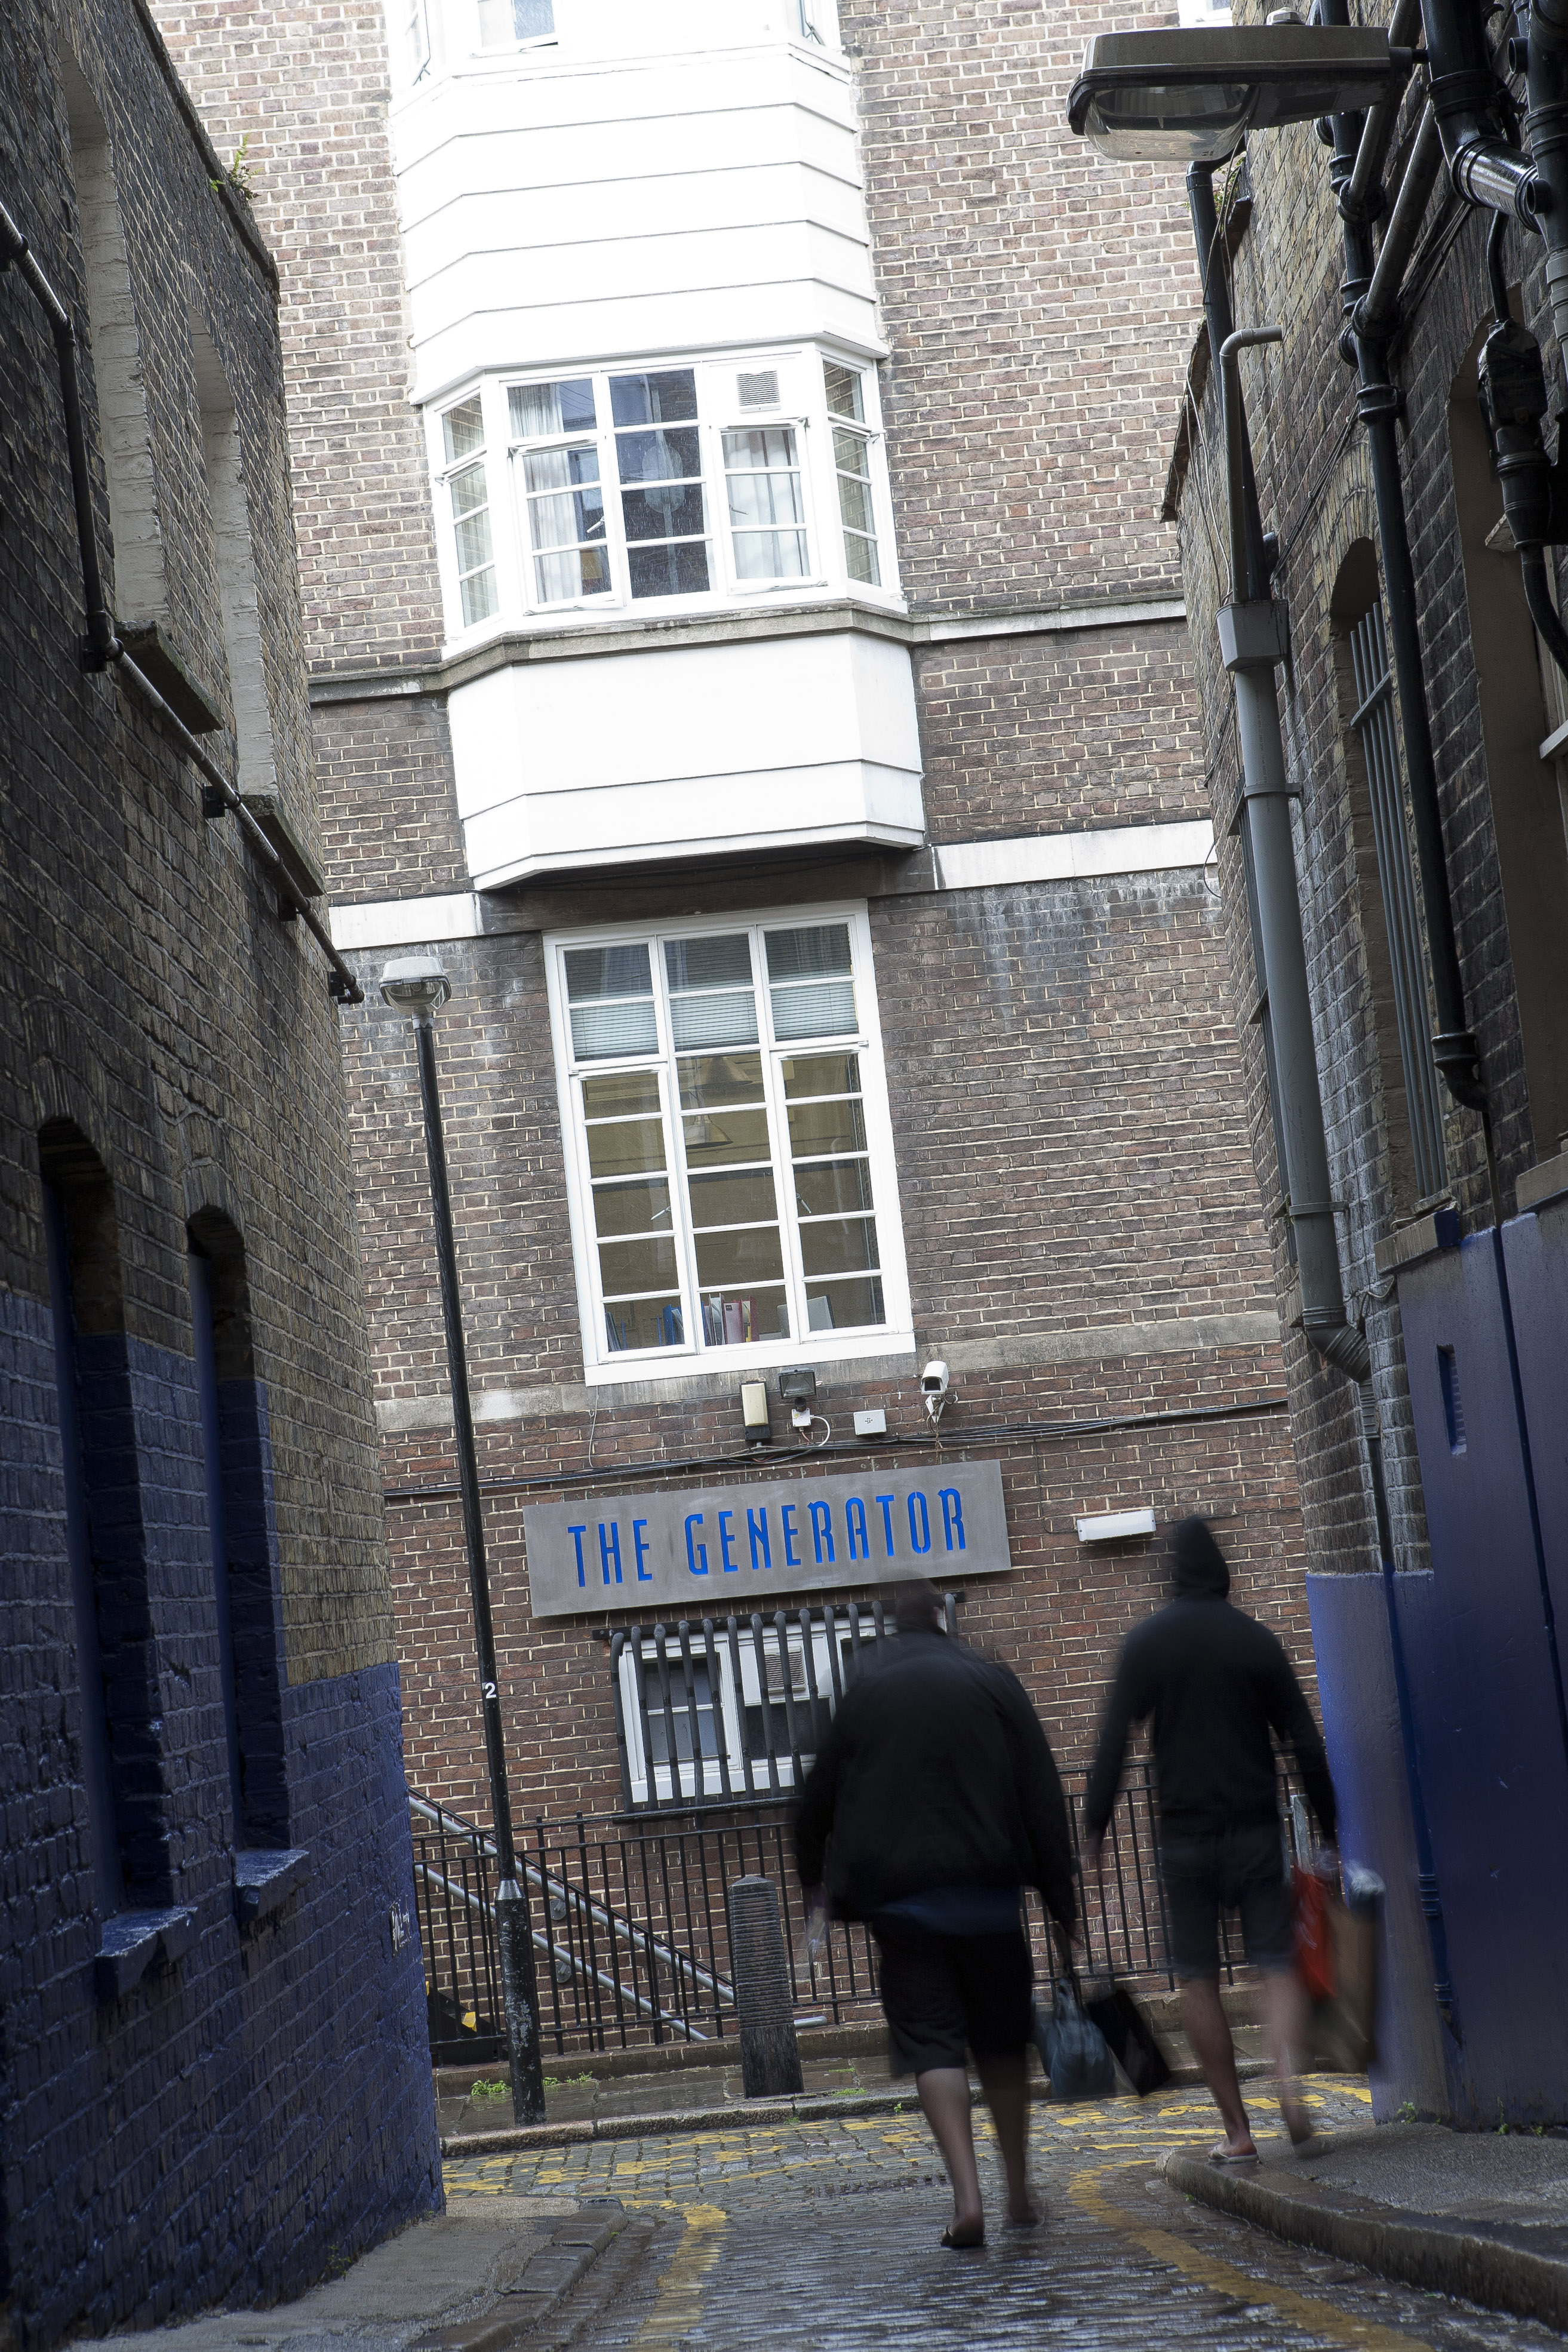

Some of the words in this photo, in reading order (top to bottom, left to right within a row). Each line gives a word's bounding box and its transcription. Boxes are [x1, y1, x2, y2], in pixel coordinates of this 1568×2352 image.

[567, 1518, 653, 1587] THE
[684, 1487, 966, 1576] GENERATOR
[485, 1682, 497, 1699] 2
